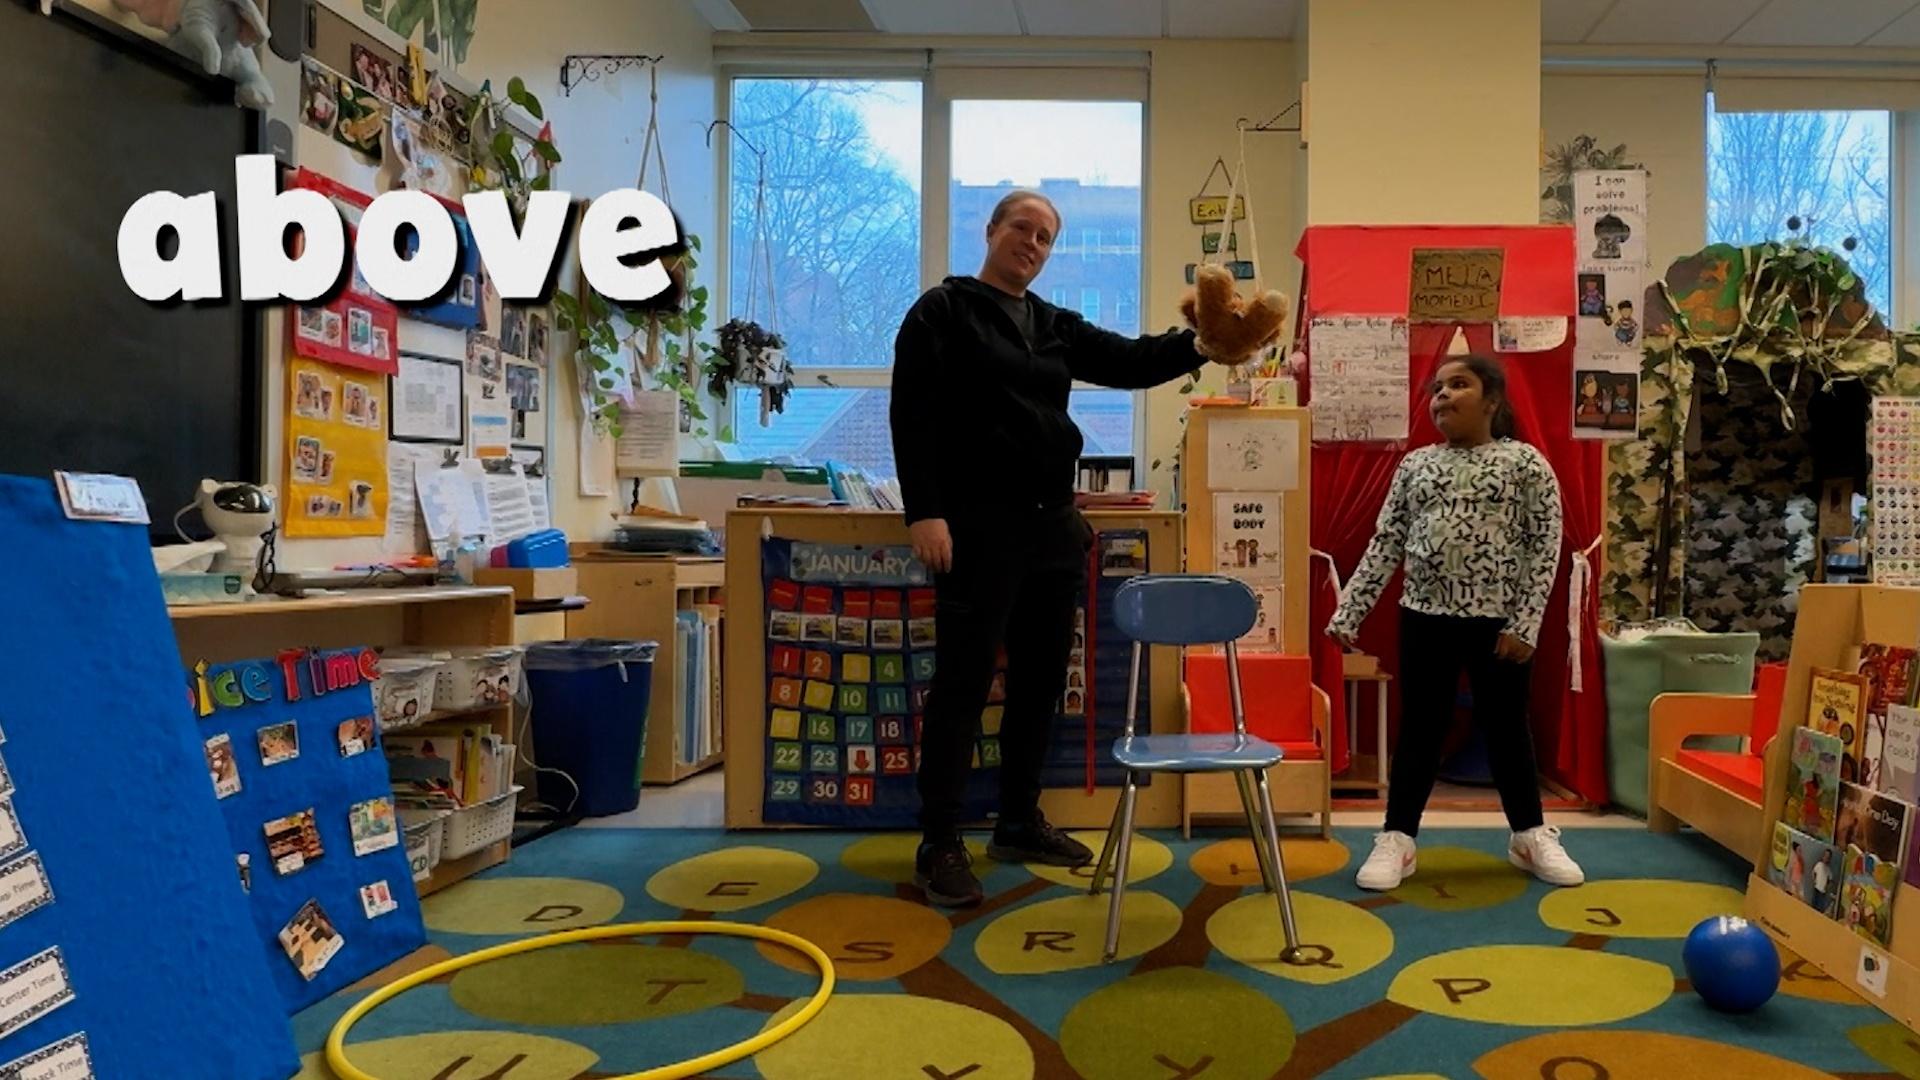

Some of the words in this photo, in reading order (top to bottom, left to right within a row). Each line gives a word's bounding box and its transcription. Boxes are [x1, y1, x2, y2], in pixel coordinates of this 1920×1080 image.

[1596, 189, 1626, 199] solve
[1232, 518, 1266, 530] BODY
[805, 553, 912, 576] JANUARY
[782, 651, 790, 670] 1
[811, 656, 824, 674] 2
[883, 660, 896, 678] 4
[920, 658, 933, 676] 5
[189, 658, 272, 717] ice
[275, 646, 383, 702] Time
[779, 684, 792, 701] 8
[842, 690, 863, 707] 10
[885, 692, 900, 709] 11
[811, 719, 830, 736] 16
[850, 721, 868, 738] 17
[880, 721, 900, 738] 18
[776, 747, 800, 766] 22
[813, 750, 837, 768] 23
[884, 752, 909, 770] 25
[773, 780, 799, 796] 29
[813, 780, 838, 798] 30
[849, 783, 869, 800] 31
[706, 881, 759, 897] E
[523, 904, 584, 923] D
[1585, 907, 1622, 926] J
[835, 941, 895, 964] S
[1021, 930, 1077, 953] R
[1279, 943, 1343, 969] Q
[31, 973, 57, 990] Time
[643, 979, 709, 1006] T
[1432, 977, 1492, 1004] P
[56, 1056, 84, 1073] Time
